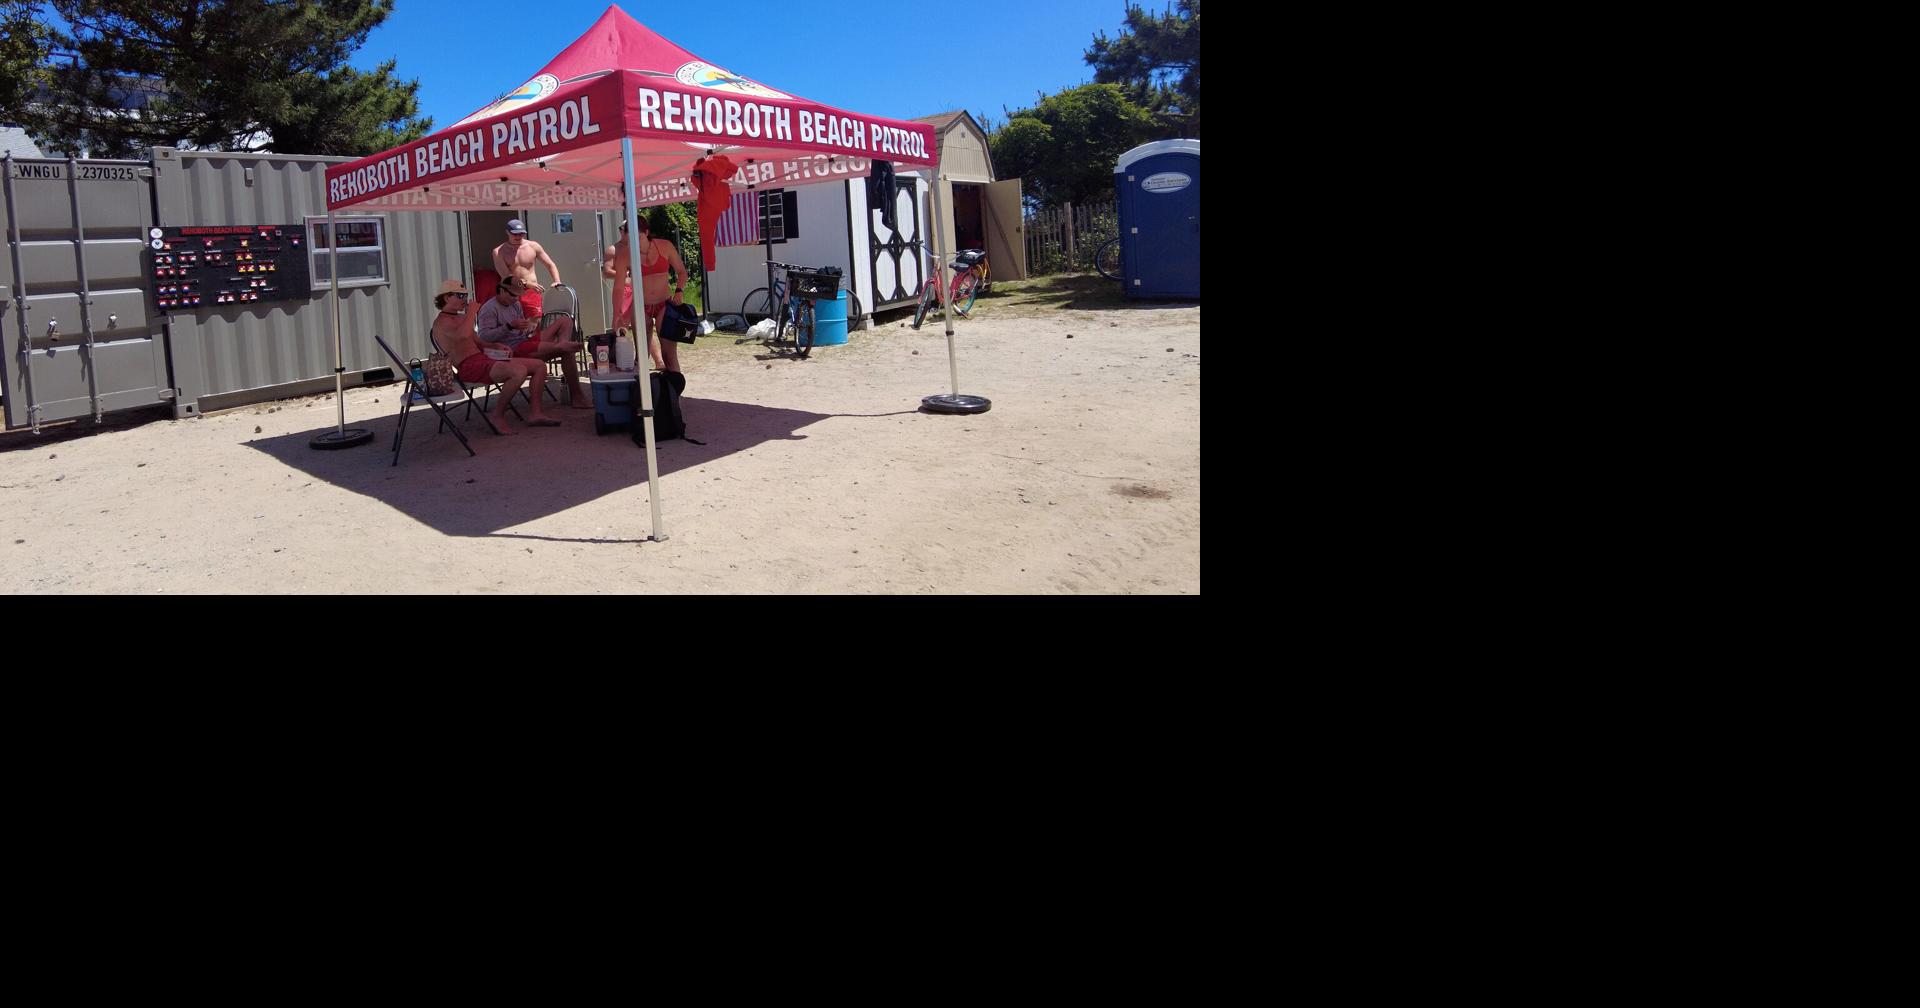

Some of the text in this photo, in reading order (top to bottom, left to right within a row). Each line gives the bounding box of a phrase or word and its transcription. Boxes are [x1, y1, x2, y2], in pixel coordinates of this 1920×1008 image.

[330, 95, 600, 204] REHOBOTH BEACH PATROL
[639, 87, 929, 159] REHOBOTH BEACH PATROL
[19, 165, 134, 179] WNGU 2370325
